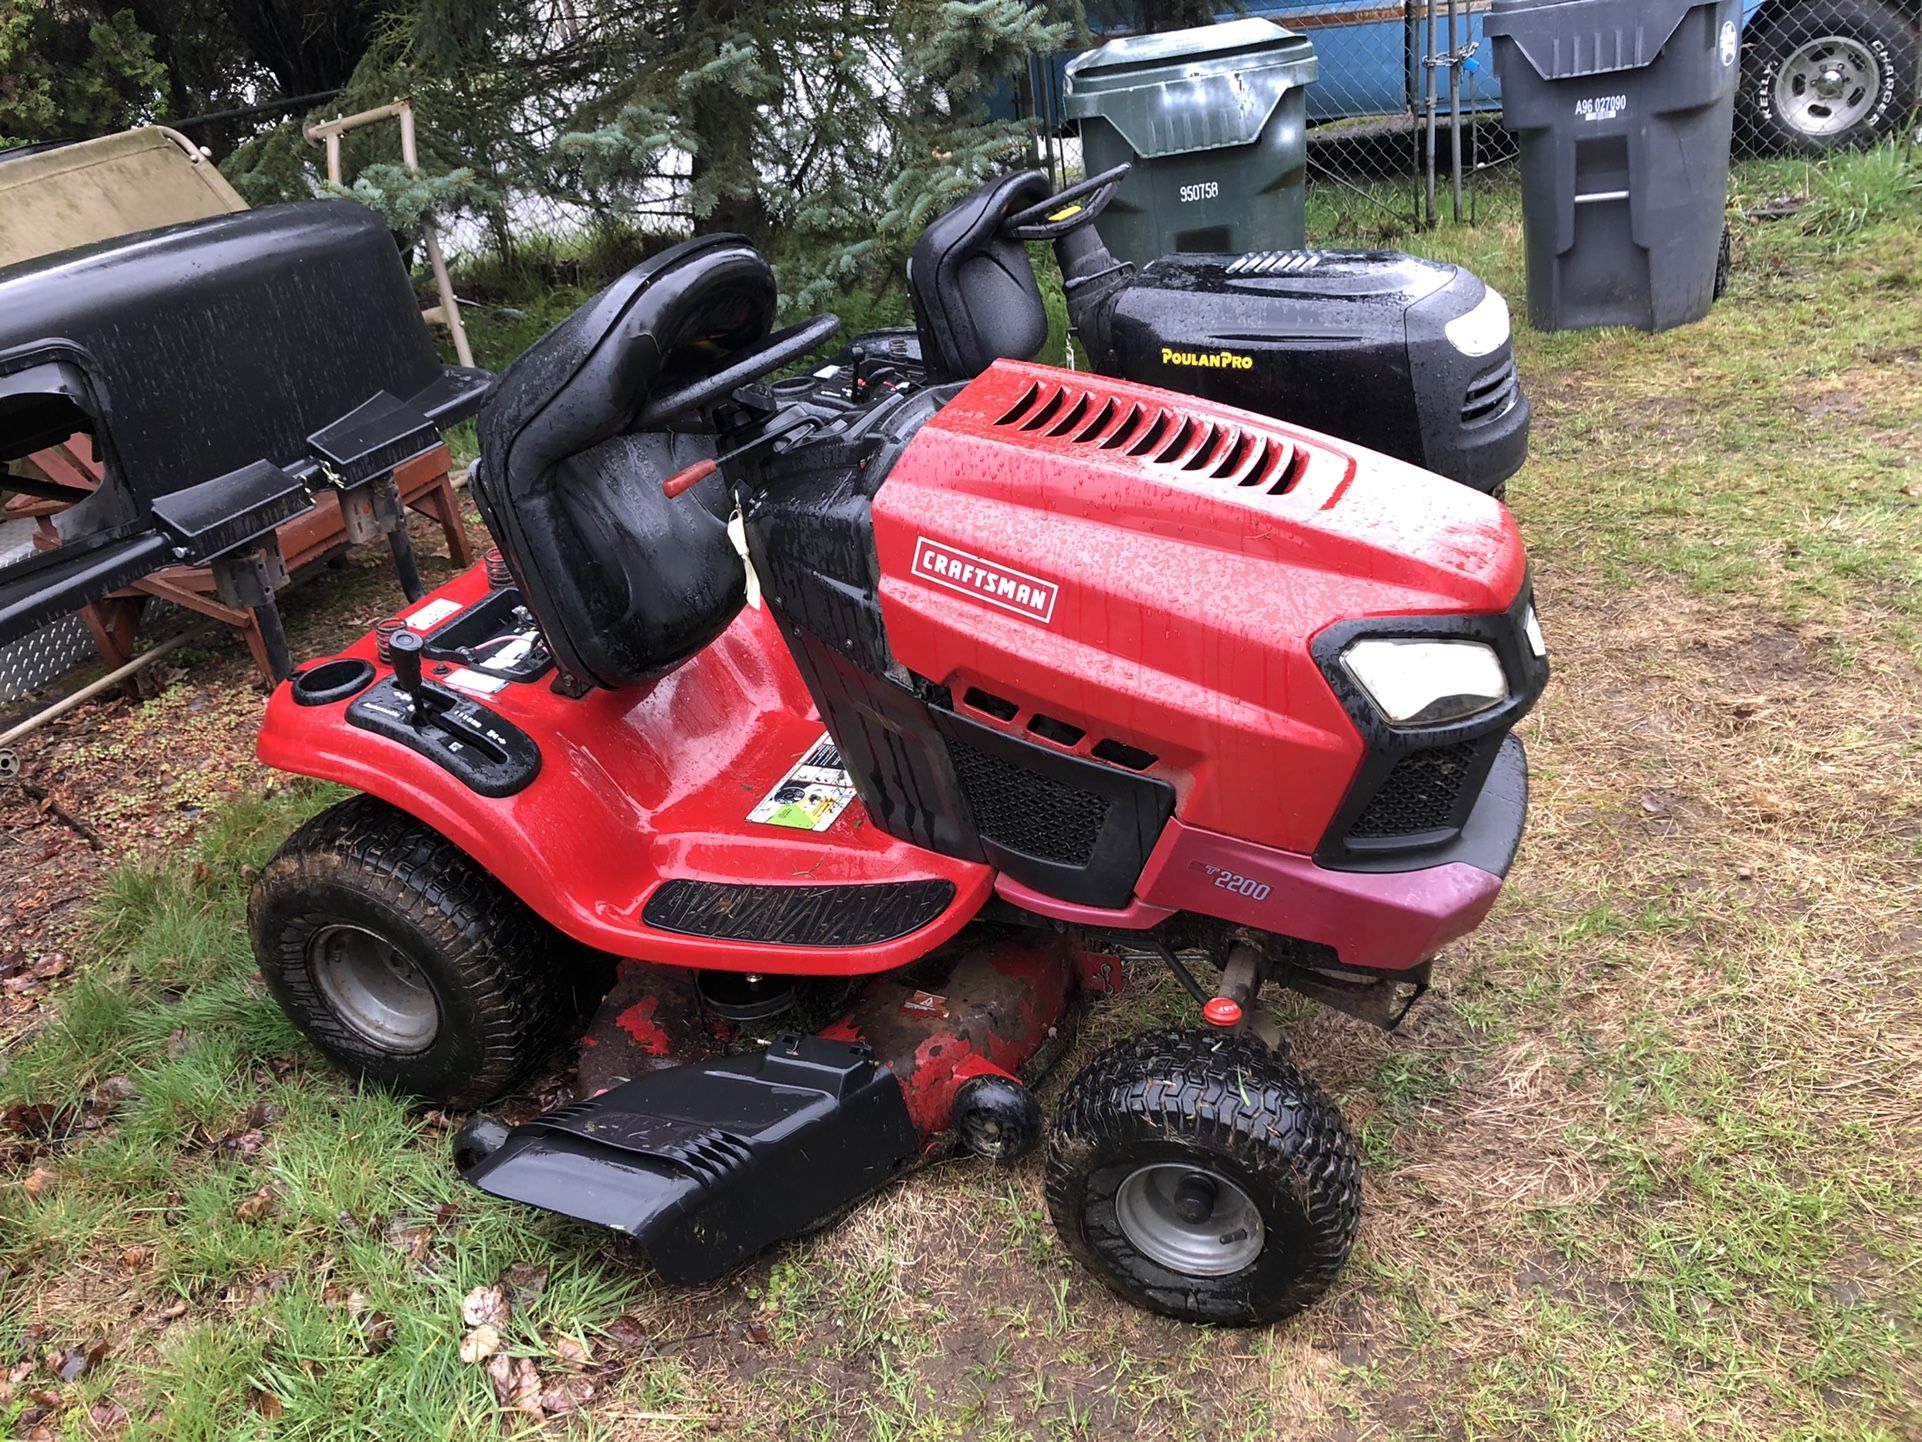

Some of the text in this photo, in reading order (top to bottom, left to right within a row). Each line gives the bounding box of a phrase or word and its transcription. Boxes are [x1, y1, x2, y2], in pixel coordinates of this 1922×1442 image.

[1868, 39, 1895, 126] CHARGER
[1575, 94, 1626, 115] A96 027090
[1180, 181, 1218, 202] 950758
[923, 550, 1047, 610] CRAFTSMAN
